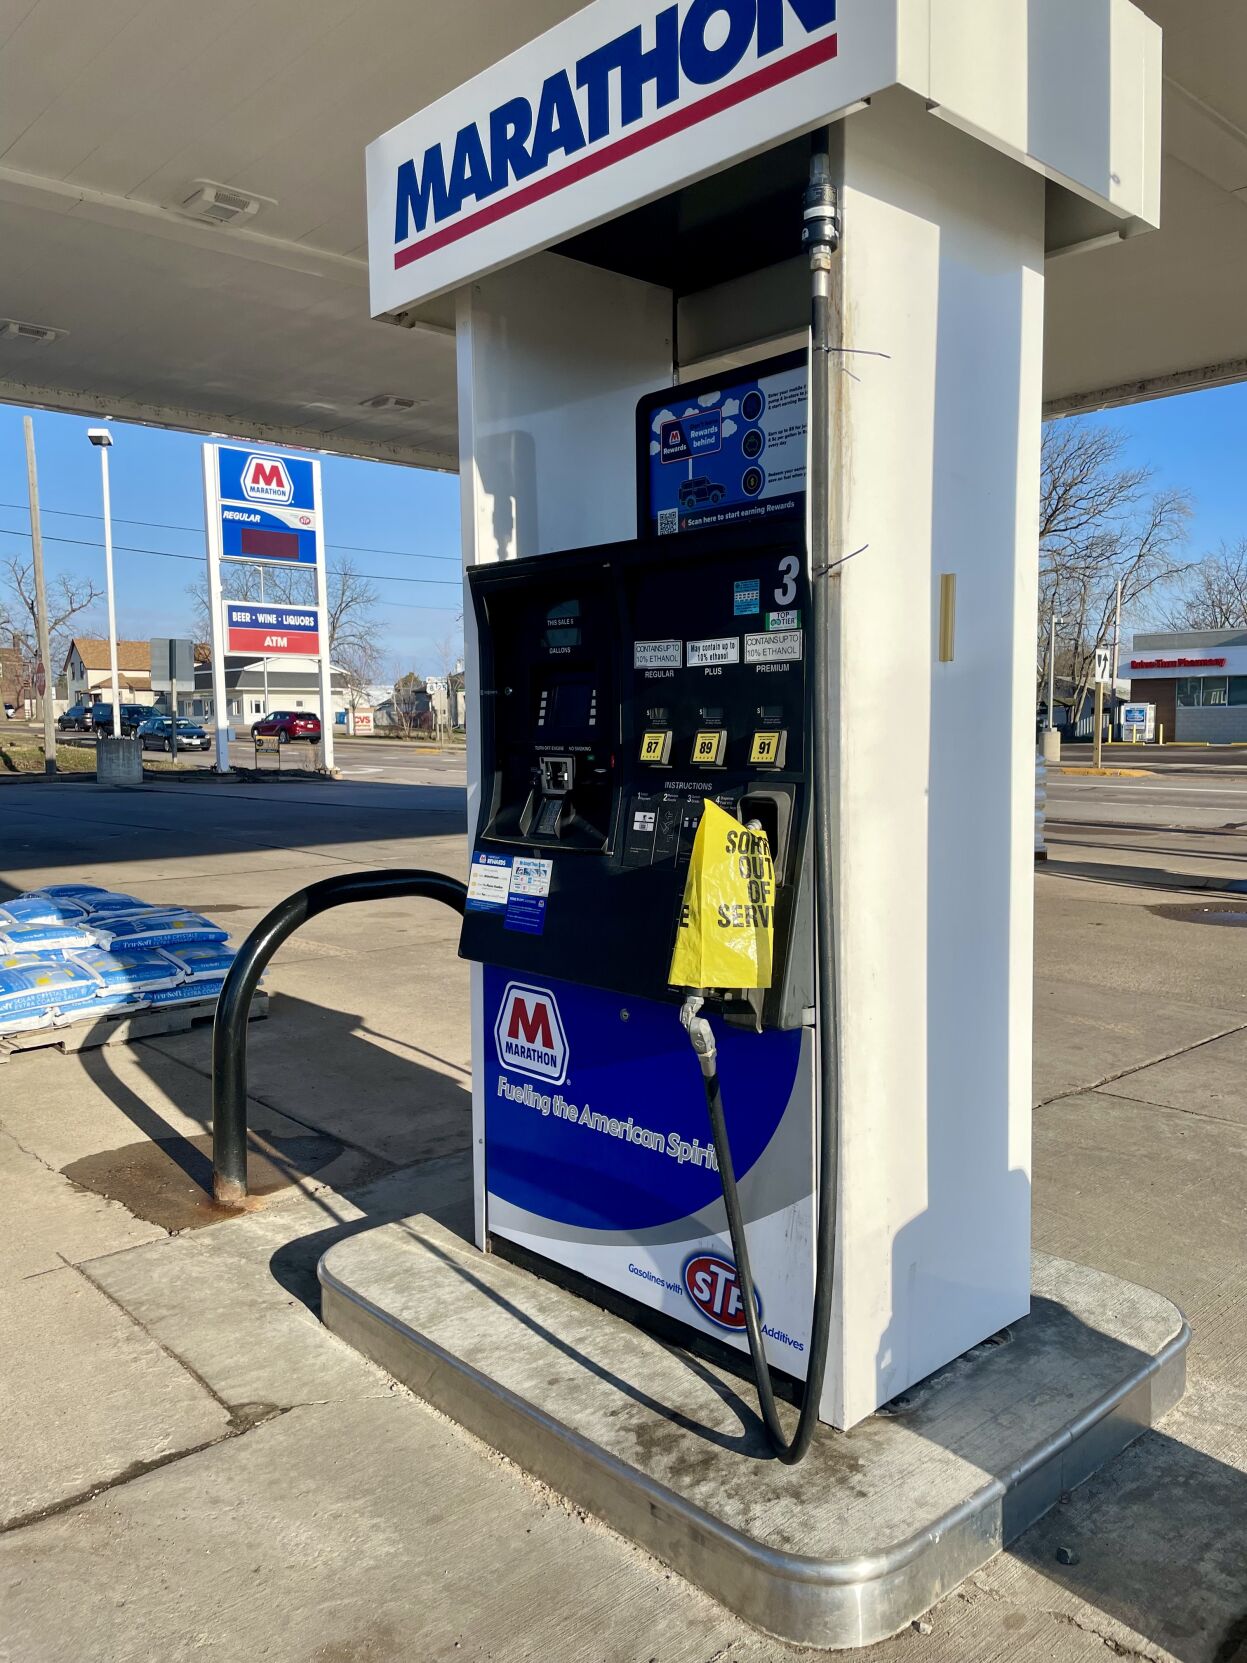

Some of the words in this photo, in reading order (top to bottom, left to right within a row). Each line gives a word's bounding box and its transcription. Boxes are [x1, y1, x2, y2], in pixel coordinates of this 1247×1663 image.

[690, 425, 718, 438] Rewards
[693, 435, 716, 448] behind
[663, 444, 687, 455] Rewards
[252, 462, 285, 488] M
[250, 486, 286, 497] MARATHON
[223, 511, 261, 523] REGULAR
[688, 518, 702, 526] Scan
[703, 515, 717, 524] here
[725, 510, 740, 520] start
[740, 507, 765, 518] earning
[766, 500, 795, 512] Rewards
[774, 554, 800, 605] 3
[232, 611, 250, 622] BEER
[257, 612, 276, 624] WINE
[283, 614, 314, 627] LIQUORS
[264, 636, 288, 648] ATM
[747, 636, 778, 646] CONTAINS
[779, 635, 788, 643] UP
[789, 634, 798, 642] TO
[691, 645, 700, 653] May
[702, 643, 720, 651] contain
[722, 643, 728, 651] up
[748, 649, 761, 657] 10%
[763, 646, 797, 656] ETHANOL
[698, 653, 708, 661] 10%
[710, 652, 728, 660] ethanol
[645, 670, 675, 678] REGULAR
[705, 667, 722, 676] PLUS
[756, 664, 790, 672] PREMIUM
[647, 742, 659, 754] 87
[700, 742, 712, 754] 89
[758, 742, 771, 754] 91
[664, 782, 712, 791] INSTRUCTIONS
[663, 793, 668, 802] 2
[687, 794, 692, 802] 3
[715, 796, 720, 804] 4
[739, 856, 772, 880] OUT
[748, 880, 770, 903] OF
[123, 940, 152, 948] TruSoft
[153, 990, 182, 1000] TruSoft
[508, 996, 554, 1050] M
[505, 1041, 557, 1068] MARATHON
[497, 1076, 551, 1116] Fueling
[552, 1095, 578, 1122] the
[578, 1104, 665, 1152] American
[666, 1132, 720, 1172] Spirit
[628, 1263, 665, 1287] Gasolines
[665, 1281, 683, 1295] with
[694, 1264, 744, 1316] STP
[761, 1324, 804, 1351] Additives
